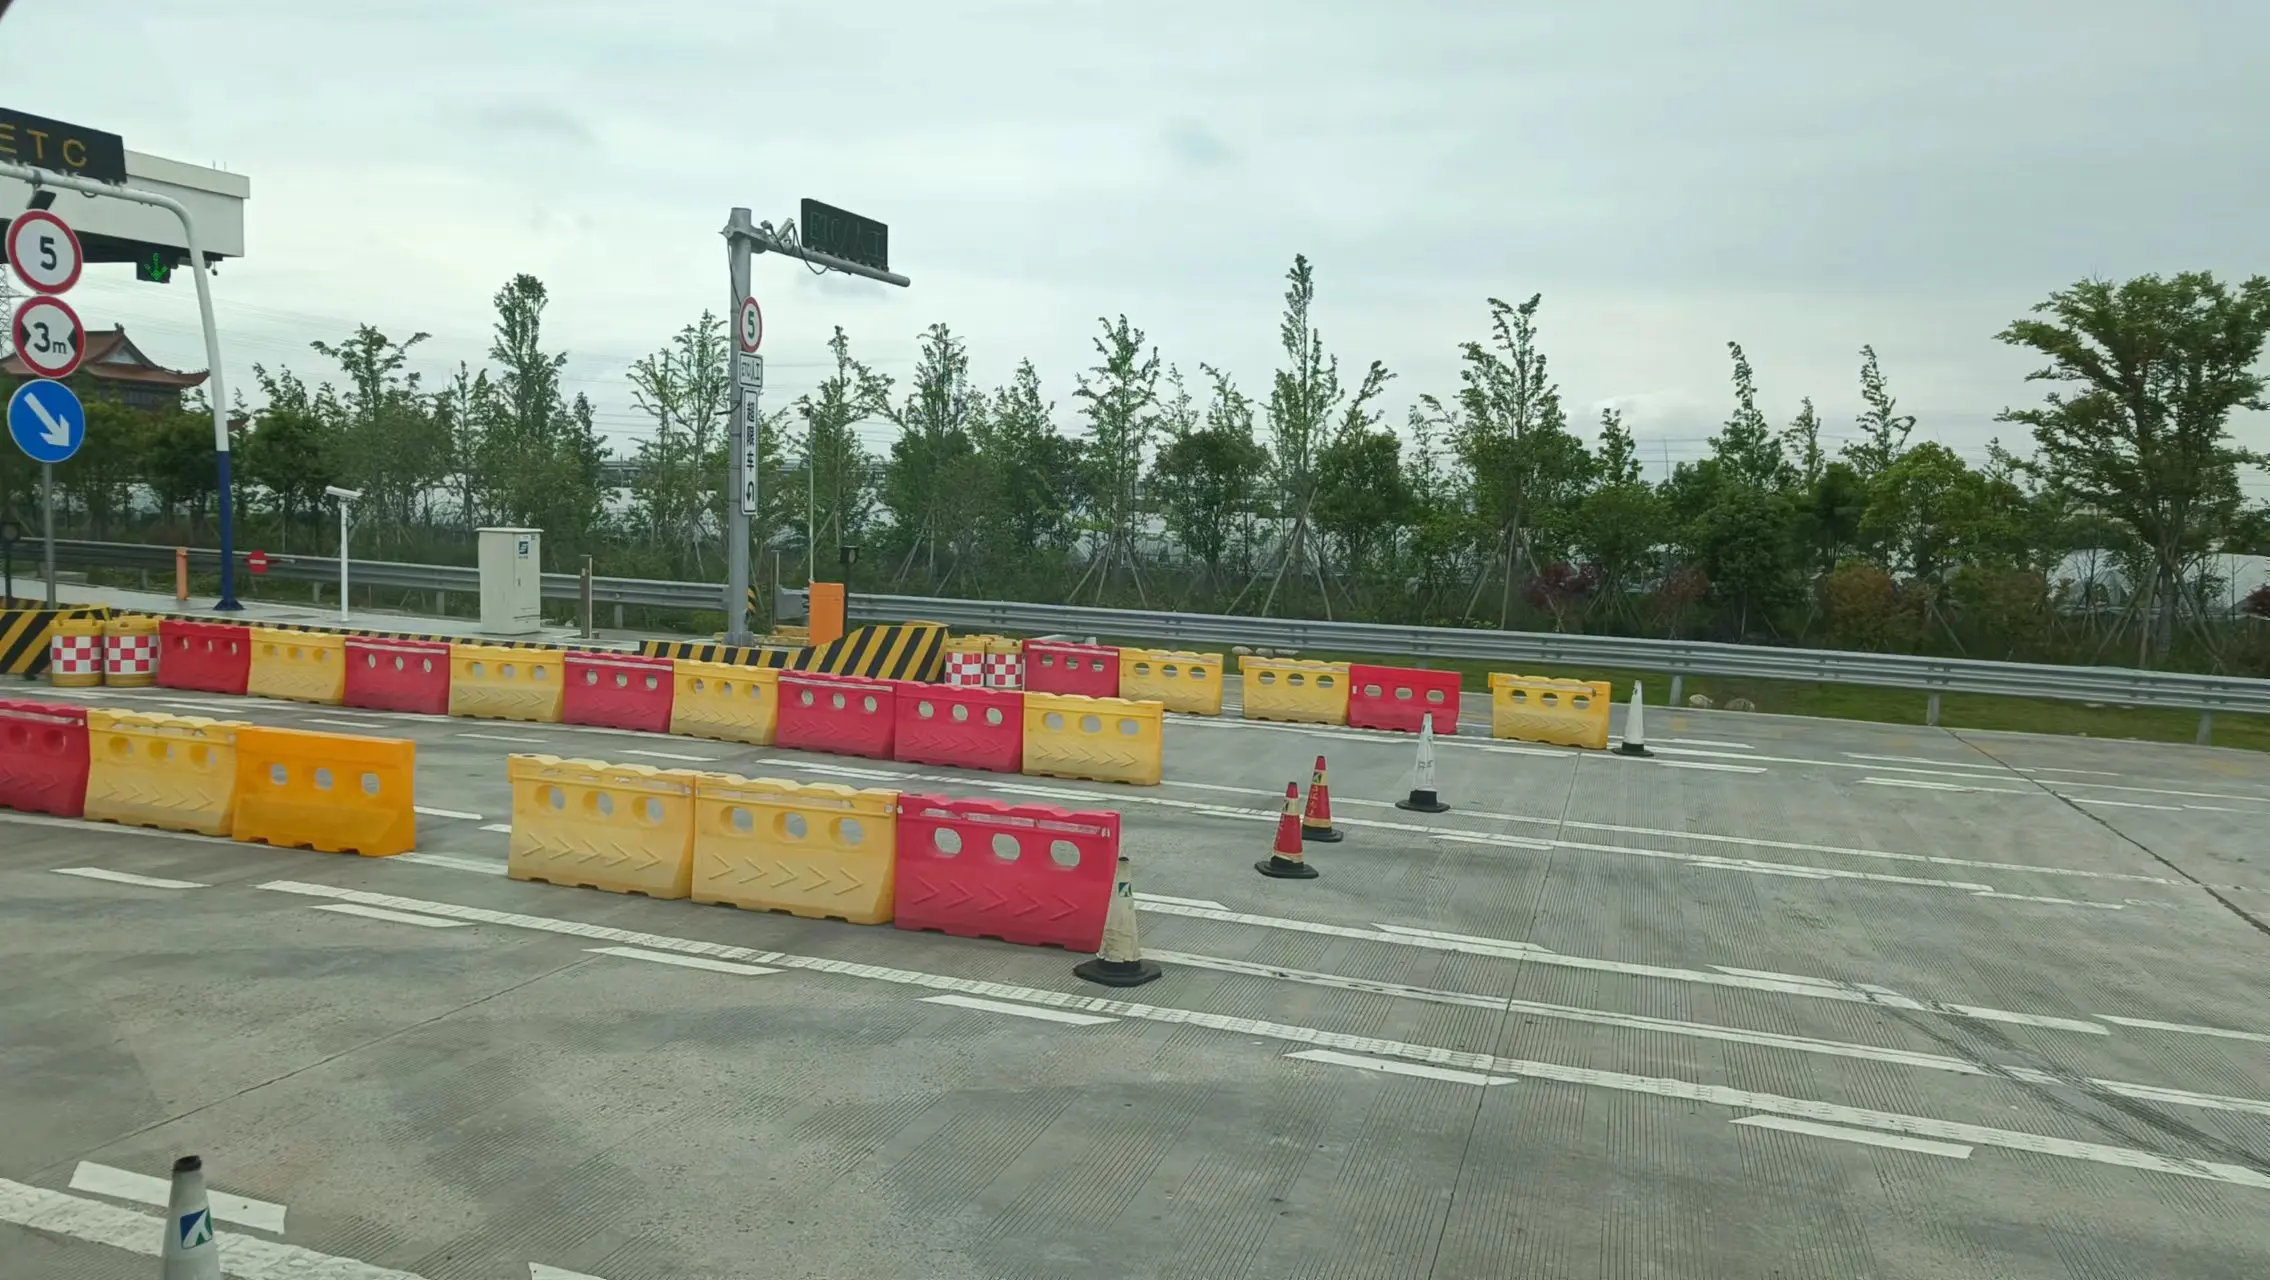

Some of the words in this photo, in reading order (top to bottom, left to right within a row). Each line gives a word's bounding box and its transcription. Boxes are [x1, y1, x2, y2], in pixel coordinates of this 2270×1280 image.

[0, 123, 88, 168] ETC
[39, 235, 58, 271] 5
[33, 321, 68, 356] 3m
[746, 310, 756, 340] 5
